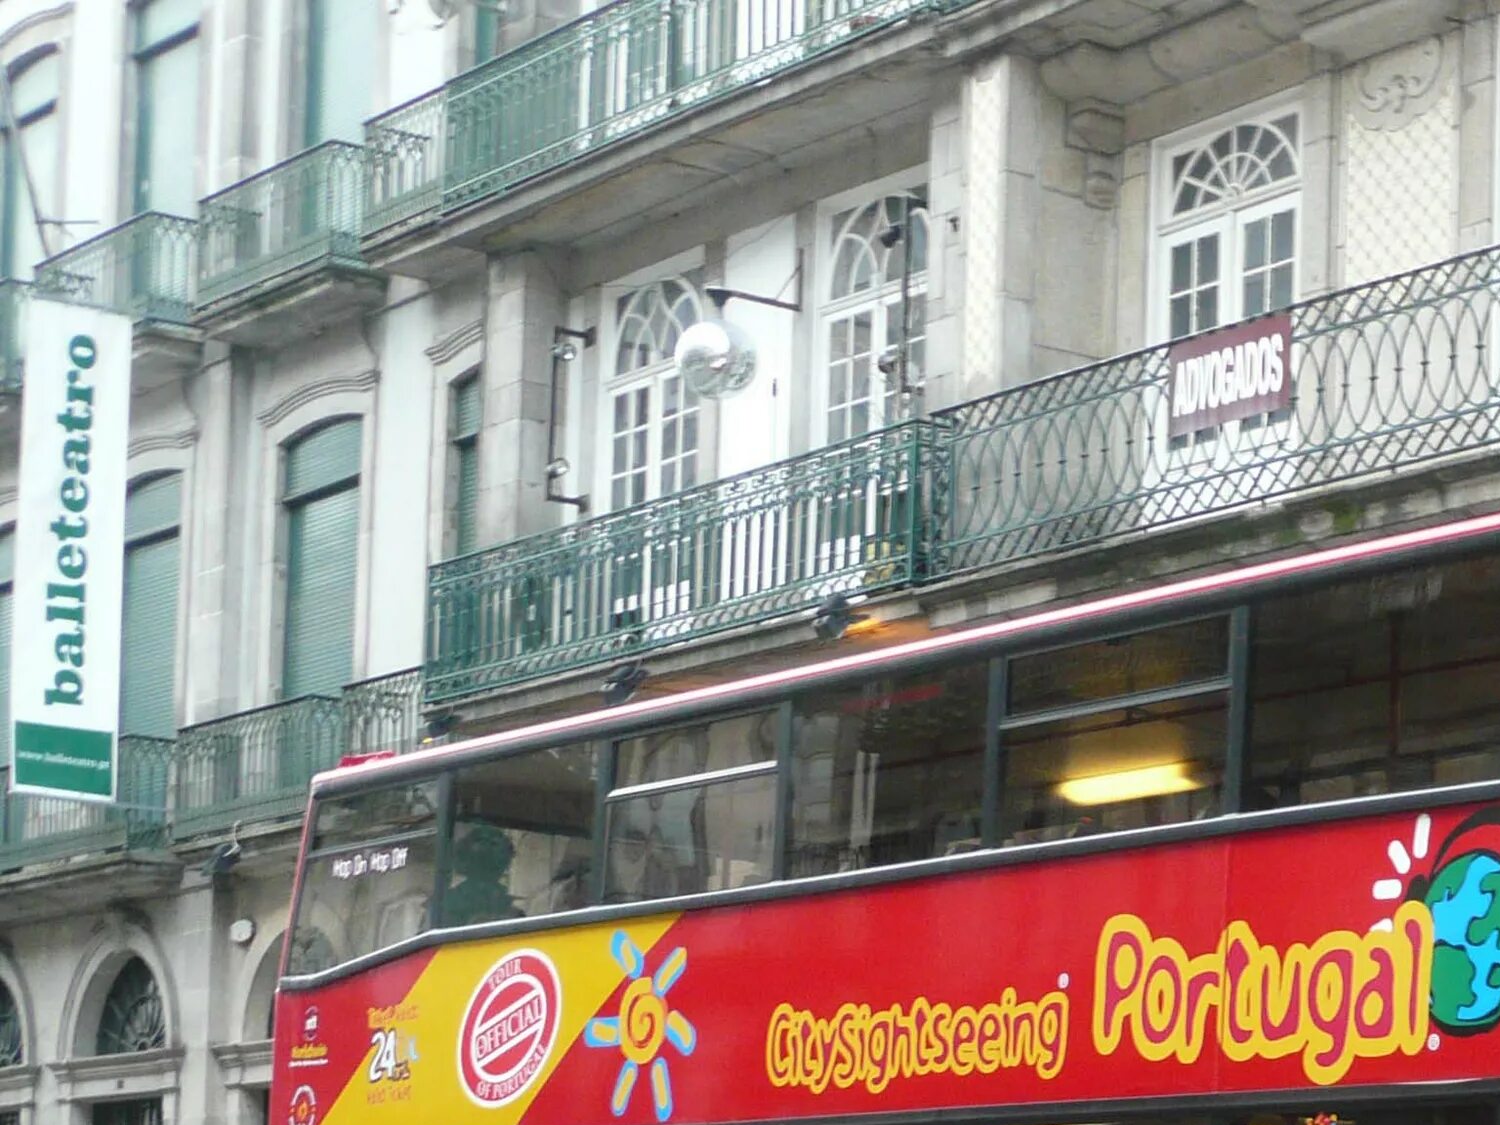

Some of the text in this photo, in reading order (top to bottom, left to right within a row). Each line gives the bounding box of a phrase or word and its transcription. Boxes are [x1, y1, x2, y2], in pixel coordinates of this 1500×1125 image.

[1172, 333, 1284, 418] ADVOGADOS
[44, 333, 98, 706] balleteatro
[331, 859, 353, 879] Hop
[369, 852, 390, 873] Hop
[391, 846, 409, 870] Off
[487, 957, 524, 991] TOUR
[1094, 899, 1433, 1085] Portugal
[370, 1029, 397, 1082] 24
[475, 994, 543, 1060] OFFICIAL
[765, 987, 1068, 1093] CitySightseeing
[475, 1043, 546, 1099] OF PORTUGAL
